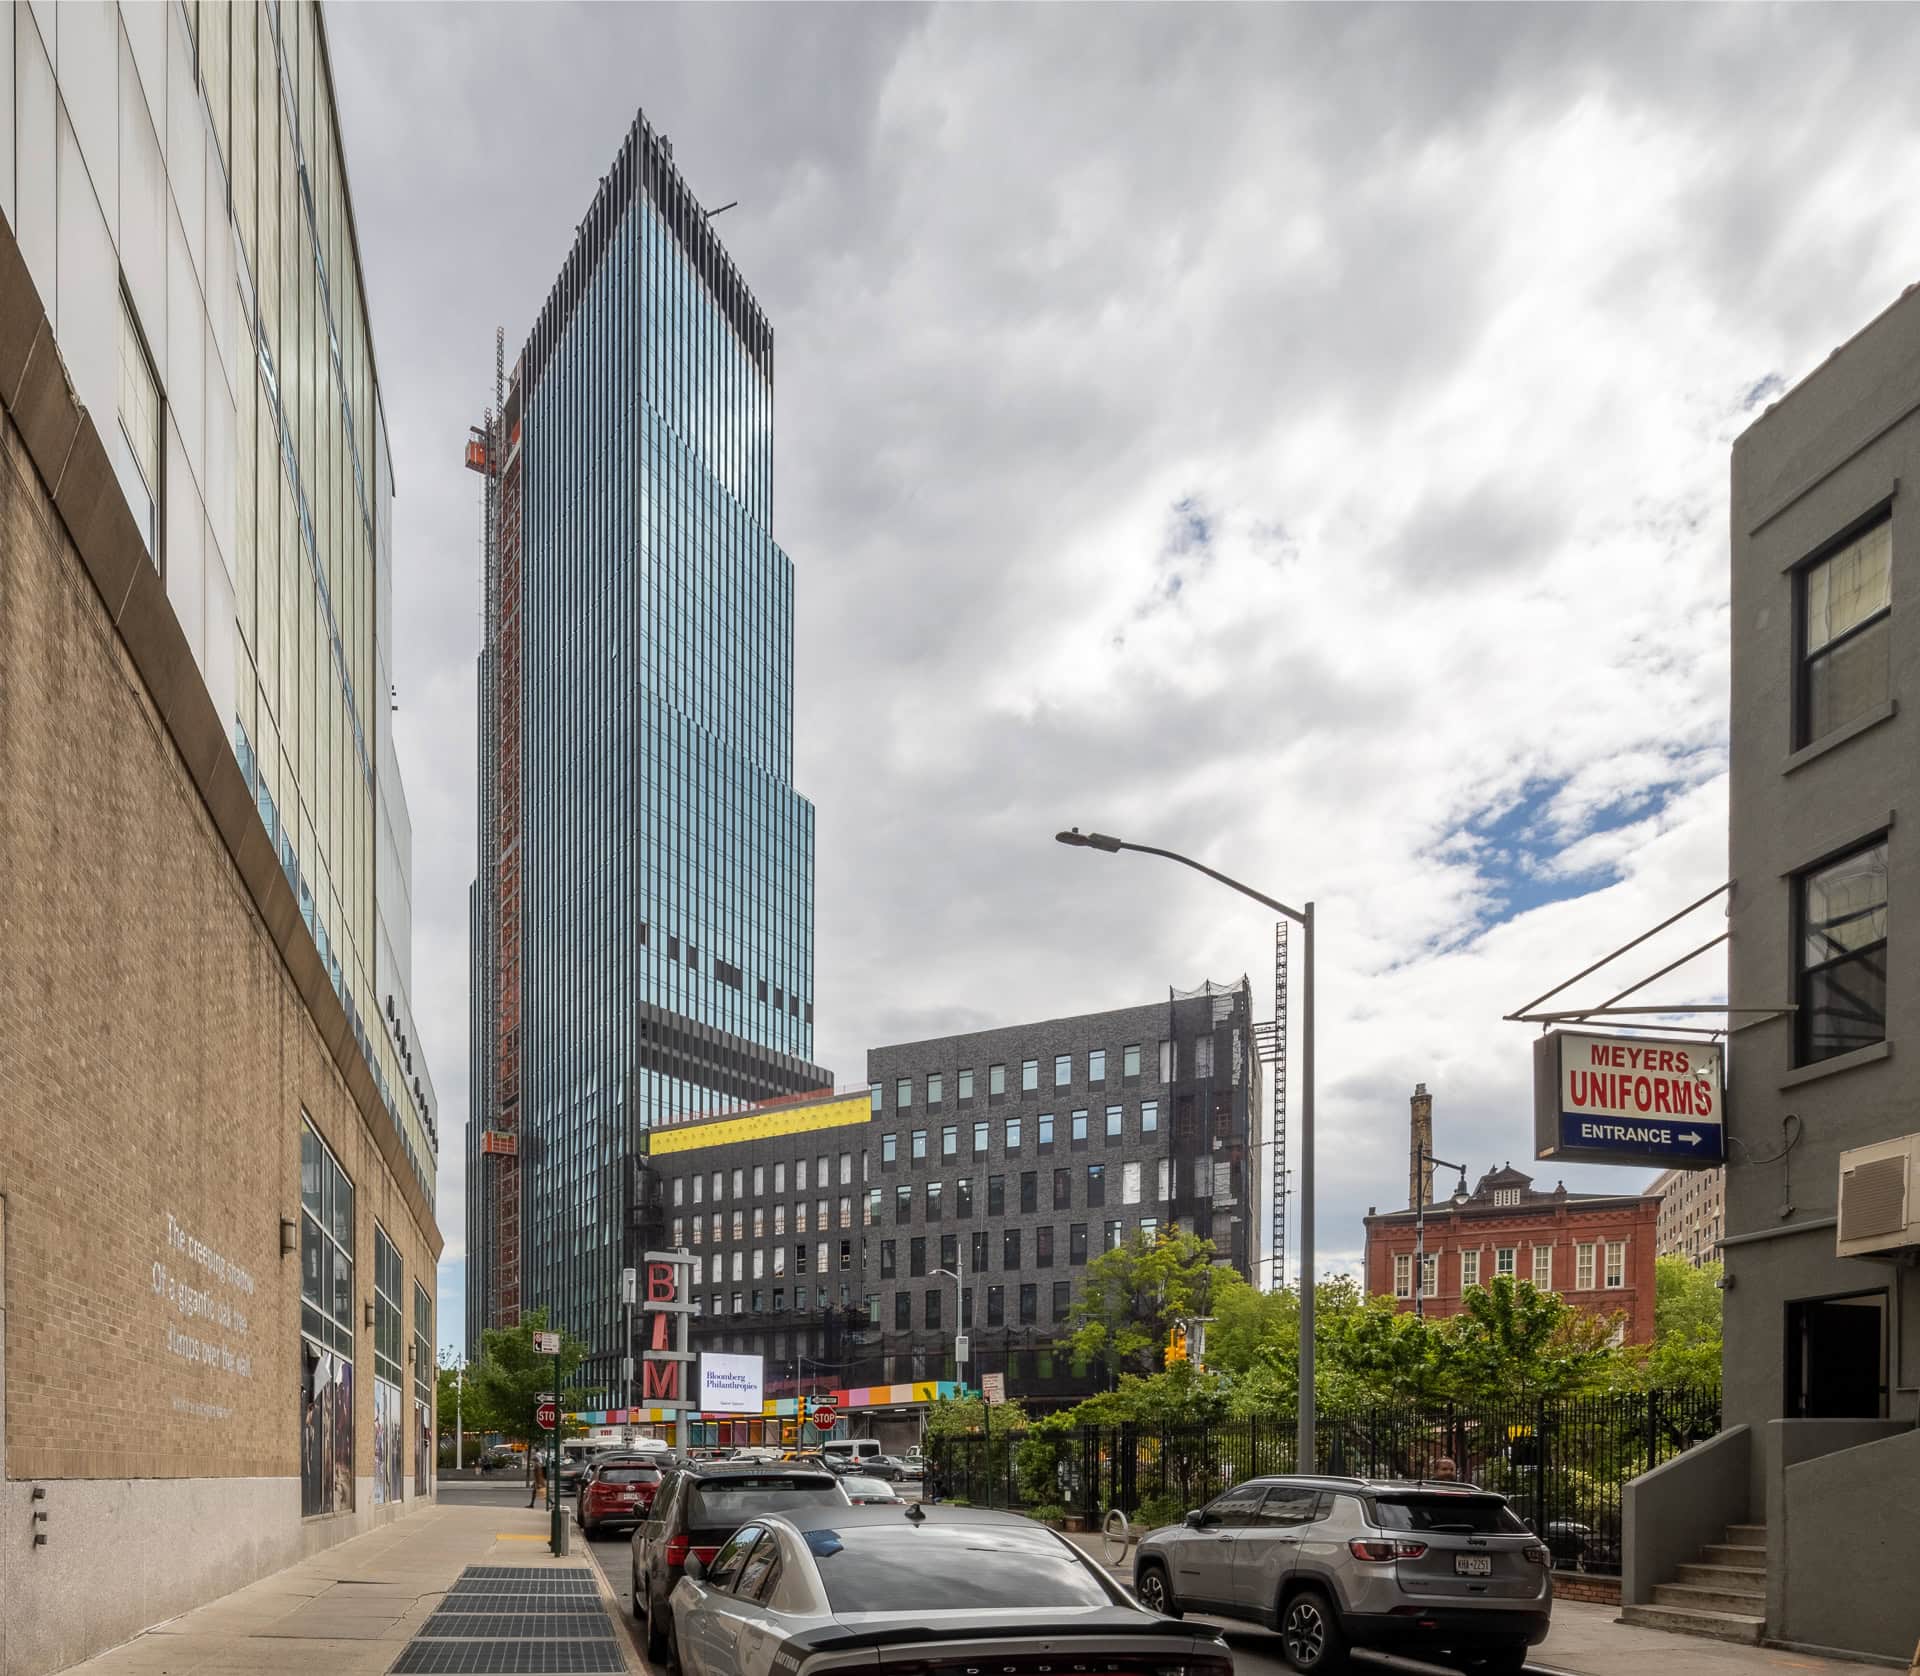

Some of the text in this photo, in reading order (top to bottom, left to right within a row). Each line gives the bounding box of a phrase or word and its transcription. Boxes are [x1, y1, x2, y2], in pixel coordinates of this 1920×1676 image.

[1591, 1044, 1689, 1073] MEYERS
[1570, 1070, 1713, 1116] UNIFORMS
[1581, 1123, 1672, 1143] ENTRANCE
[168, 1214, 186, 1251] The
[188, 1236, 225, 1284] creeping
[152, 1261, 166, 1295] Of
[169, 1278, 175, 1301] a
[178, 1280, 215, 1319] gigantic
[642, 1263, 678, 1399] BAM
[167, 1320, 200, 1363] Jumps
[201, 1342, 220, 1368] over
[222, 1343, 235, 1372] the
[706, 1370, 746, 1383] Bloomberg
[706, 1380, 758, 1393] Philanthropies
[539, 1411, 555, 1421] STO
[814, 1413, 836, 1424] STOP
